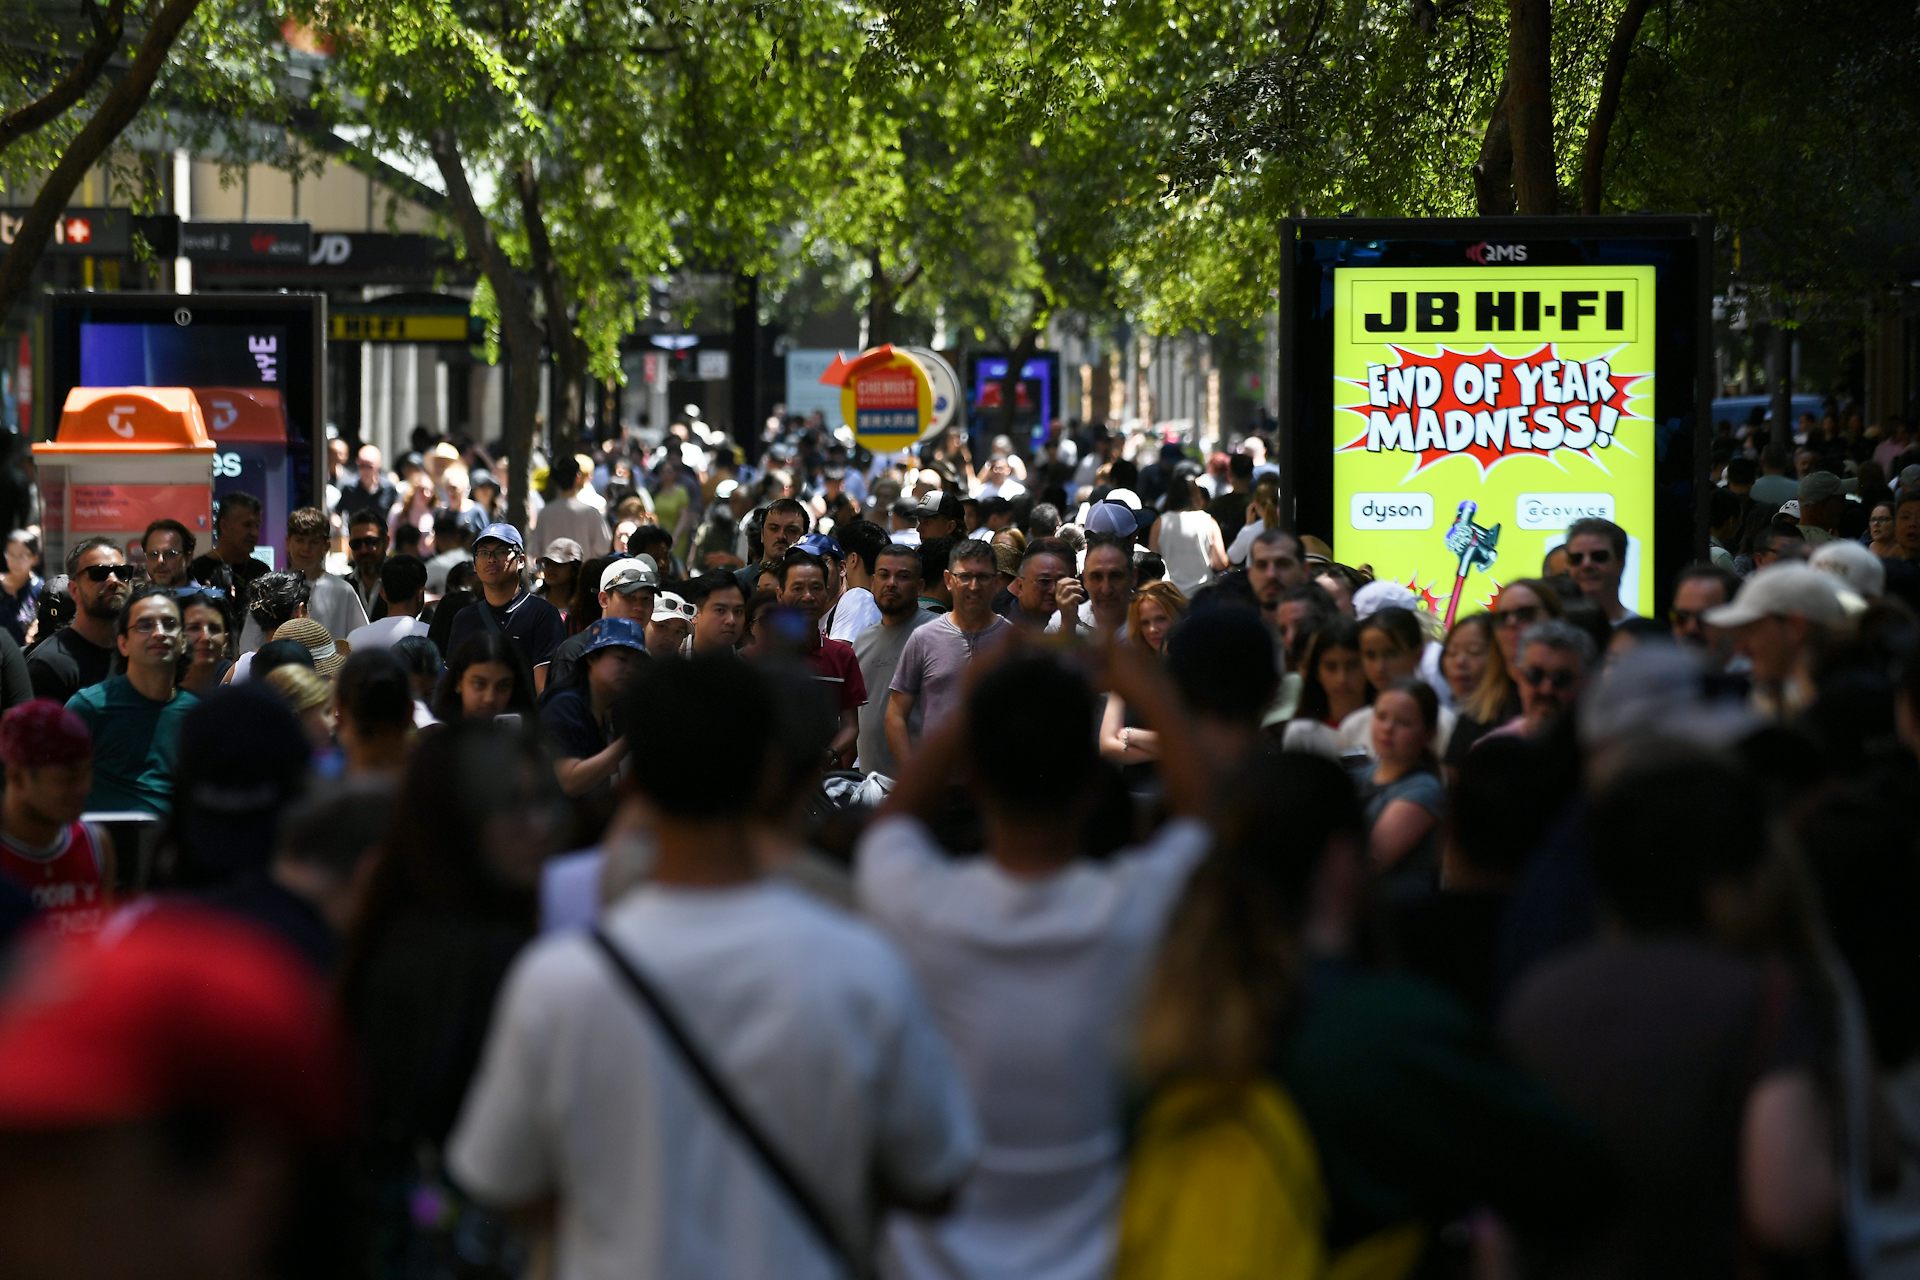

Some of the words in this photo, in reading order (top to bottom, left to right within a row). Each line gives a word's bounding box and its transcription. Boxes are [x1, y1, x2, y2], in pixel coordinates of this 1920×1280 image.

[309, 234, 351, 265] JD
[1475, 243, 1528, 262] QMS
[1364, 291, 1460, 333] JB
[248, 335, 277, 382] NYE
[1367, 364, 1443, 409] END
[1453, 362, 1503, 407] OF
[1512, 359, 1617, 406] YEAR
[1367, 403, 1620, 453] MADNESS!
[1362, 500, 1422, 523] dyson
